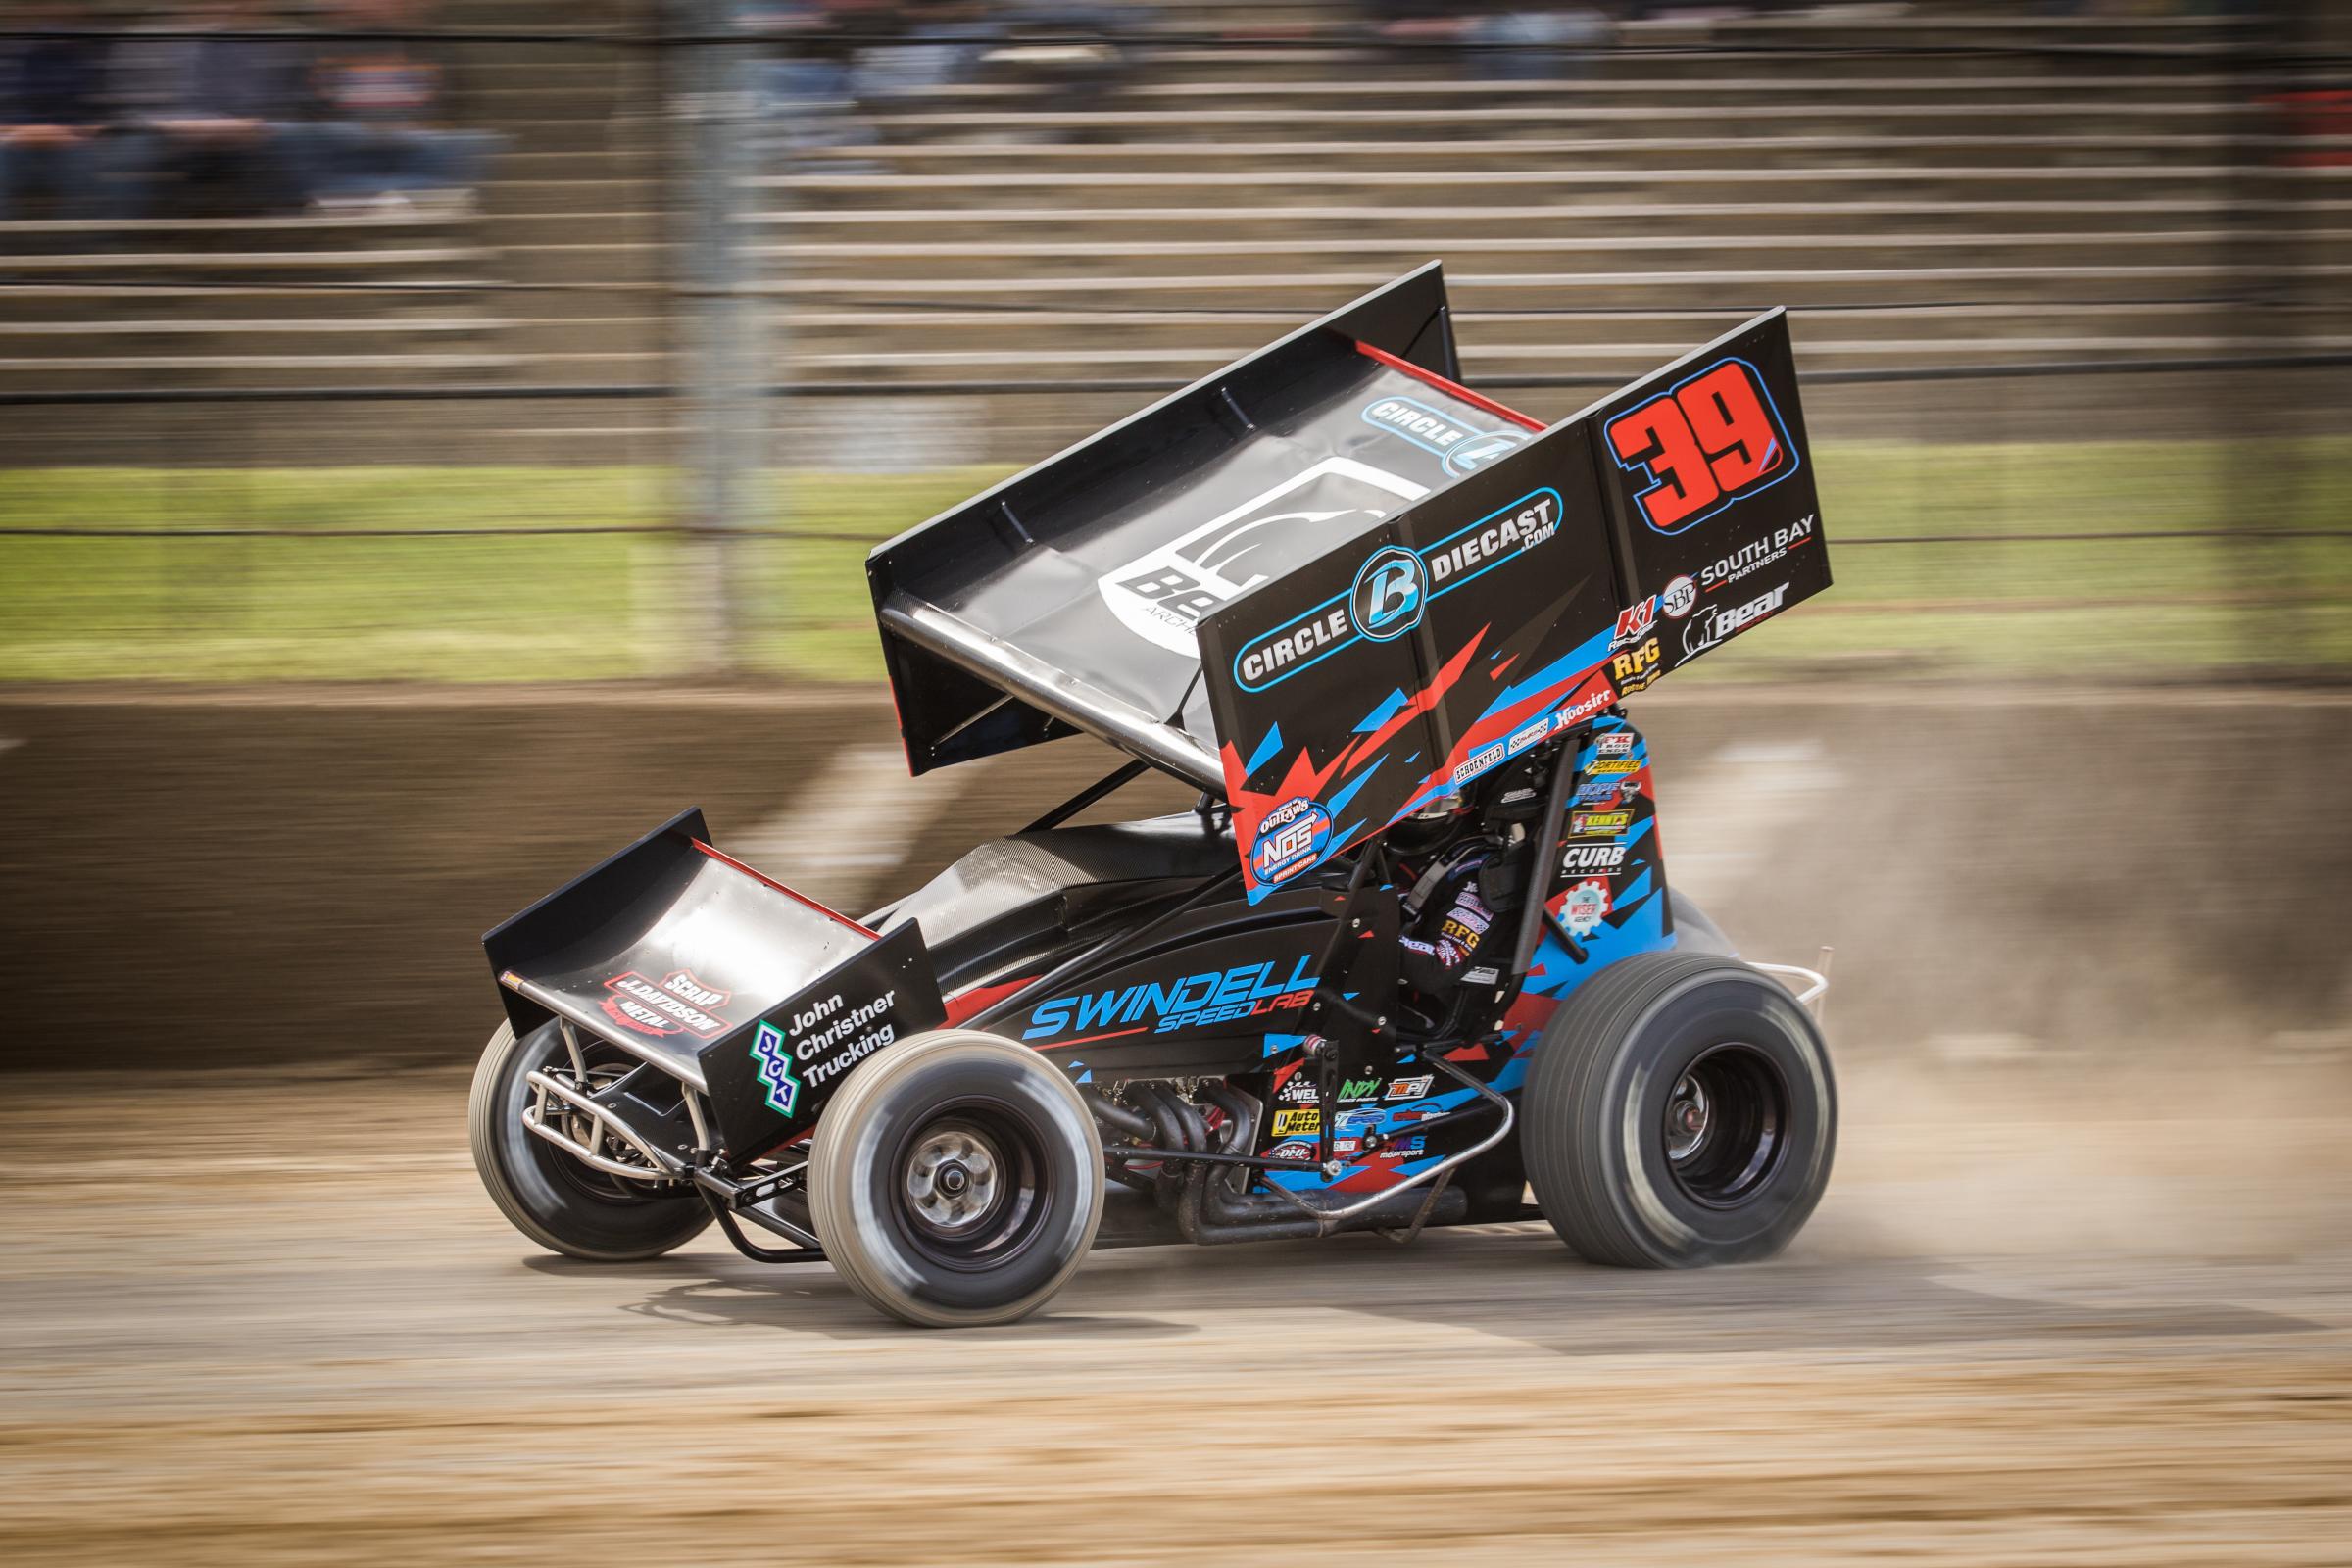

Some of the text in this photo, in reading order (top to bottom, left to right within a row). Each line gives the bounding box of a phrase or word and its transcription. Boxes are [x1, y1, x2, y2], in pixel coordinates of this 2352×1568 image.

[1372, 401, 1464, 447] CIRCLE
[1610, 363, 1783, 527] 39
[1700, 514, 1815, 586] SOUTH BAY
[1727, 547, 1788, 583] PARTNERS
[1243, 609, 1348, 681] CIRCLE
[1431, 499, 1552, 582] DIECAST
[1662, 582, 1695, 614] SBP
[1613, 594, 1657, 639] K1
[1715, 581, 1790, 639] Bear
[1612, 637, 1661, 680] RFG
[1553, 689, 1611, 731] Hoosier
[1456, 748, 1503, 780] SCHOENFELD
[1260, 799, 1309, 834] OUTLAWS
[1263, 812, 1319, 869] NOS
[1562, 846, 1626, 868] CURB
[1264, 845, 1312, 875] ENERGY DRINK
[1273, 853, 1317, 883] SPRINT CARS
[1441, 919, 1480, 949] RFG
[616, 979, 721, 1031] J.DAVIDSON
[664, 973, 724, 1006] SCRAP
[1022, 954, 1320, 1040] SWINDELL
[619, 1001, 670, 1028] METAL
[789, 994, 844, 1037] John
[796, 990, 895, 1061] Christner
[1154, 990, 1315, 1034] SPEEDLAB
[803, 1024, 895, 1088] Trucking
[1292, 1088, 1319, 1101] WEL
[1337, 1078, 1382, 1101] INDY
[1287, 1121, 1320, 1132] Meter
[1289, 1111, 1319, 1122] Auto
[1280, 1147, 1304, 1158] DMI
[1380, 1150, 1424, 1159] motorsport
